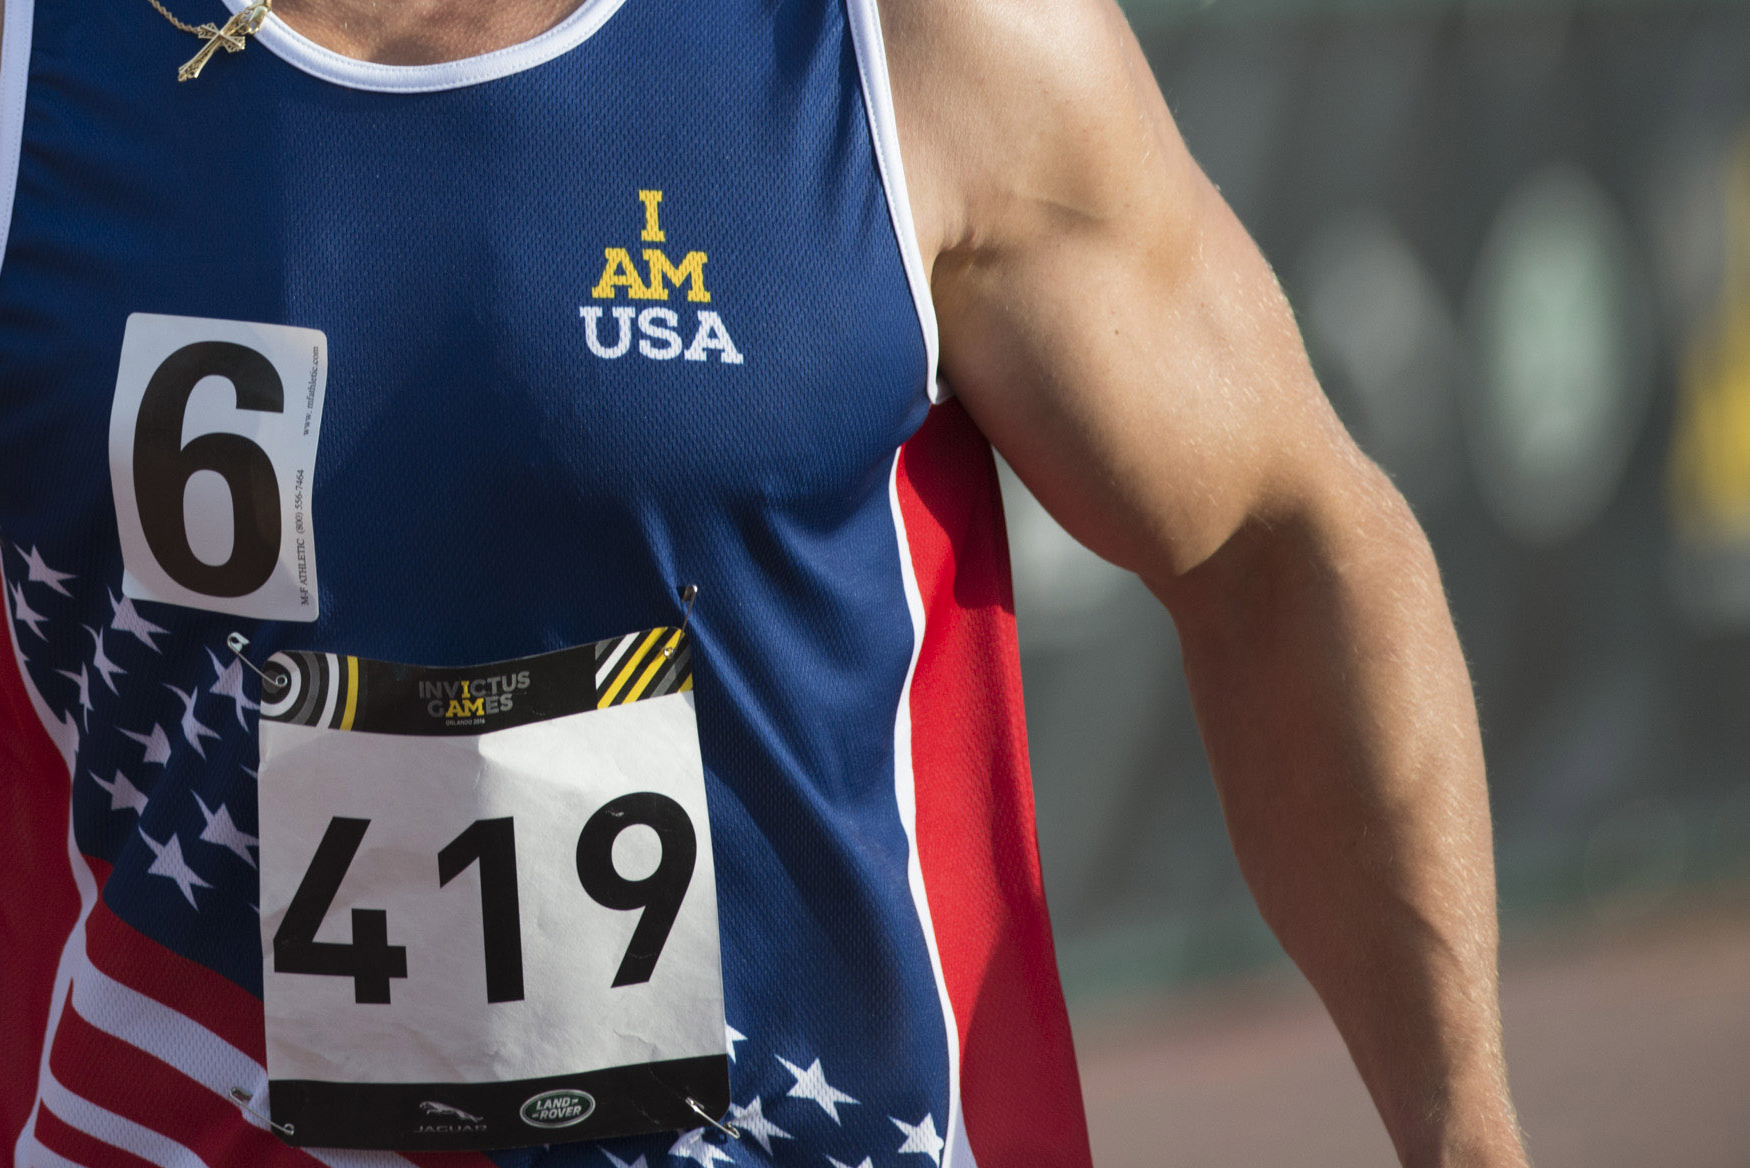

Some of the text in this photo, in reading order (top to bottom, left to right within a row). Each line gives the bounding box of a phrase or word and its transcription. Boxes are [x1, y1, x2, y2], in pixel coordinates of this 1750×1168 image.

[639, 189, 666, 242] I
[591, 247, 711, 303] AM
[579, 306, 744, 365] USA
[131, 340, 285, 598] 6
[294, 469, 304, 510] 556-7464
[295, 512, 305, 534] (800)
[296, 538, 307, 586] ATHLETIC
[418, 671, 531, 700] INVICTUS
[427, 693, 514, 718] GAMES
[445, 719, 473, 727] ORLANDO
[273, 790, 698, 1004] 419
[536, 1096, 571, 1111] LAND
[539, 1105, 582, 1120] ROVER
[413, 1124, 488, 1134] JAGUAR
